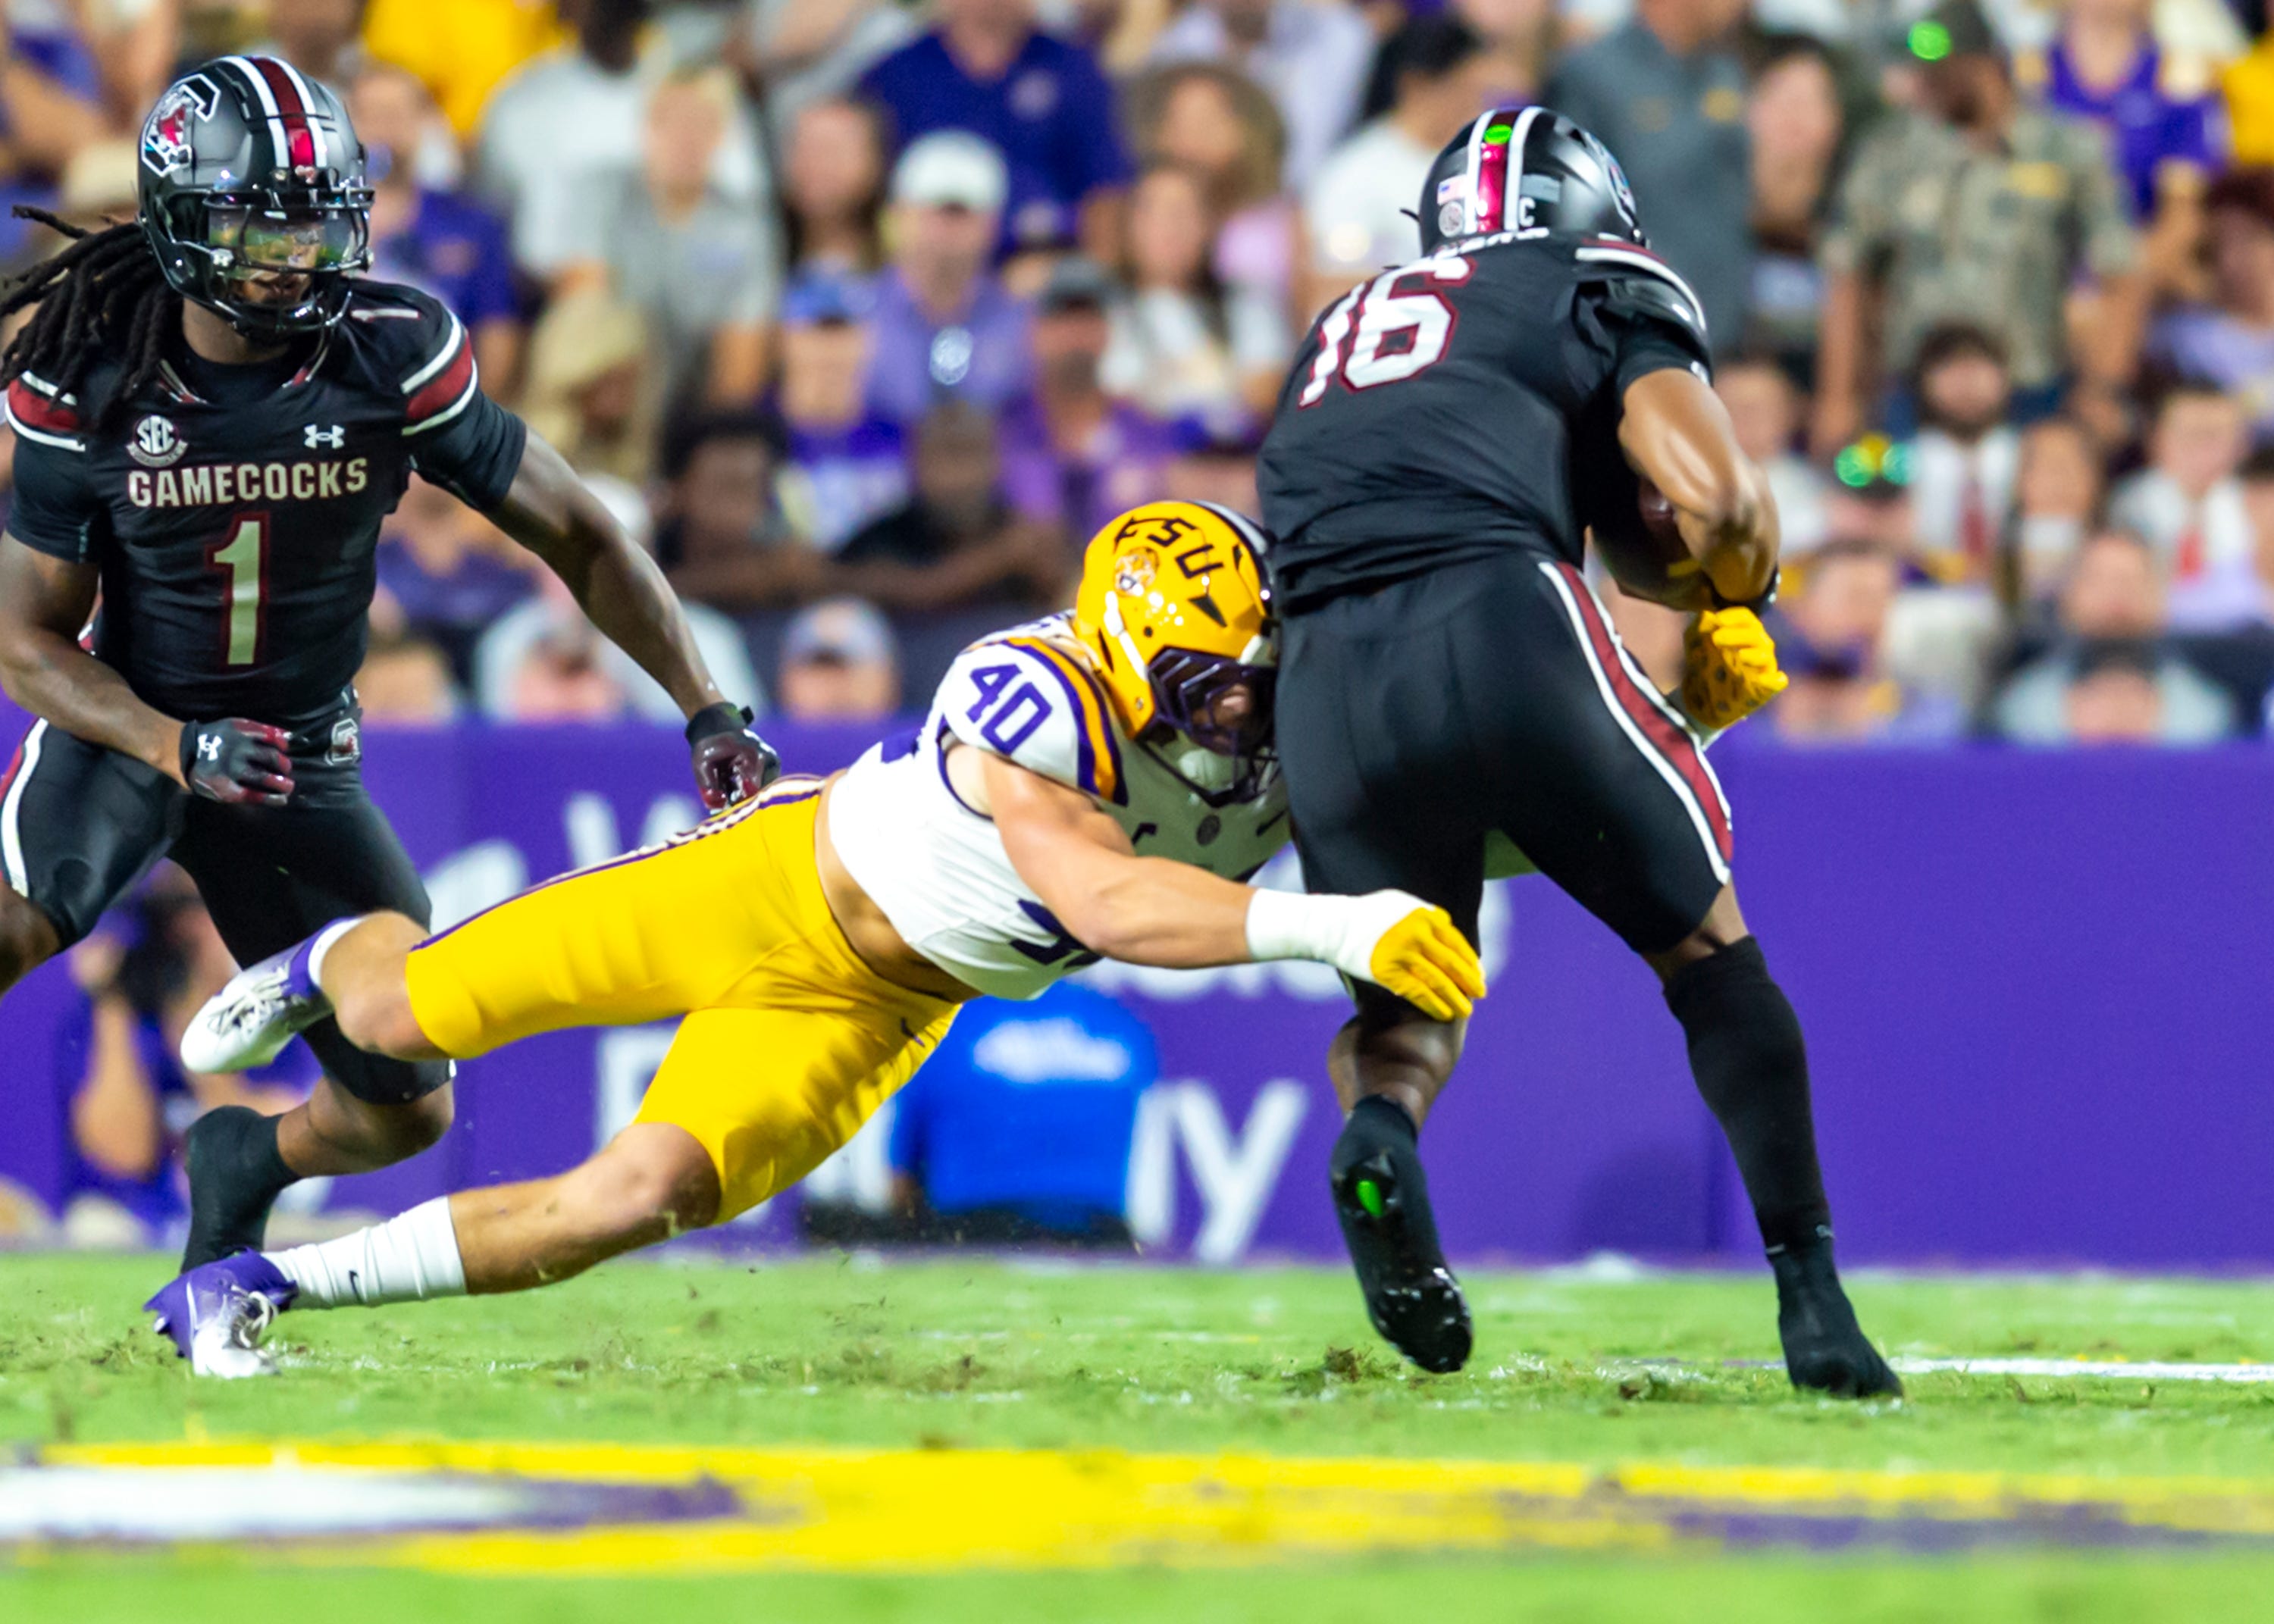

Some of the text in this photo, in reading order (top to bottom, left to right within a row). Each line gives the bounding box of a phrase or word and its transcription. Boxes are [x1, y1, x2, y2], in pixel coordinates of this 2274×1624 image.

[1518, 196, 1536, 227] C
[1298, 255, 1477, 409] 16
[137, 415, 174, 454] SEC
[127, 457, 368, 508] GAMECOCKS
[209, 515, 265, 667] 1
[966, 663, 1053, 756] 40
